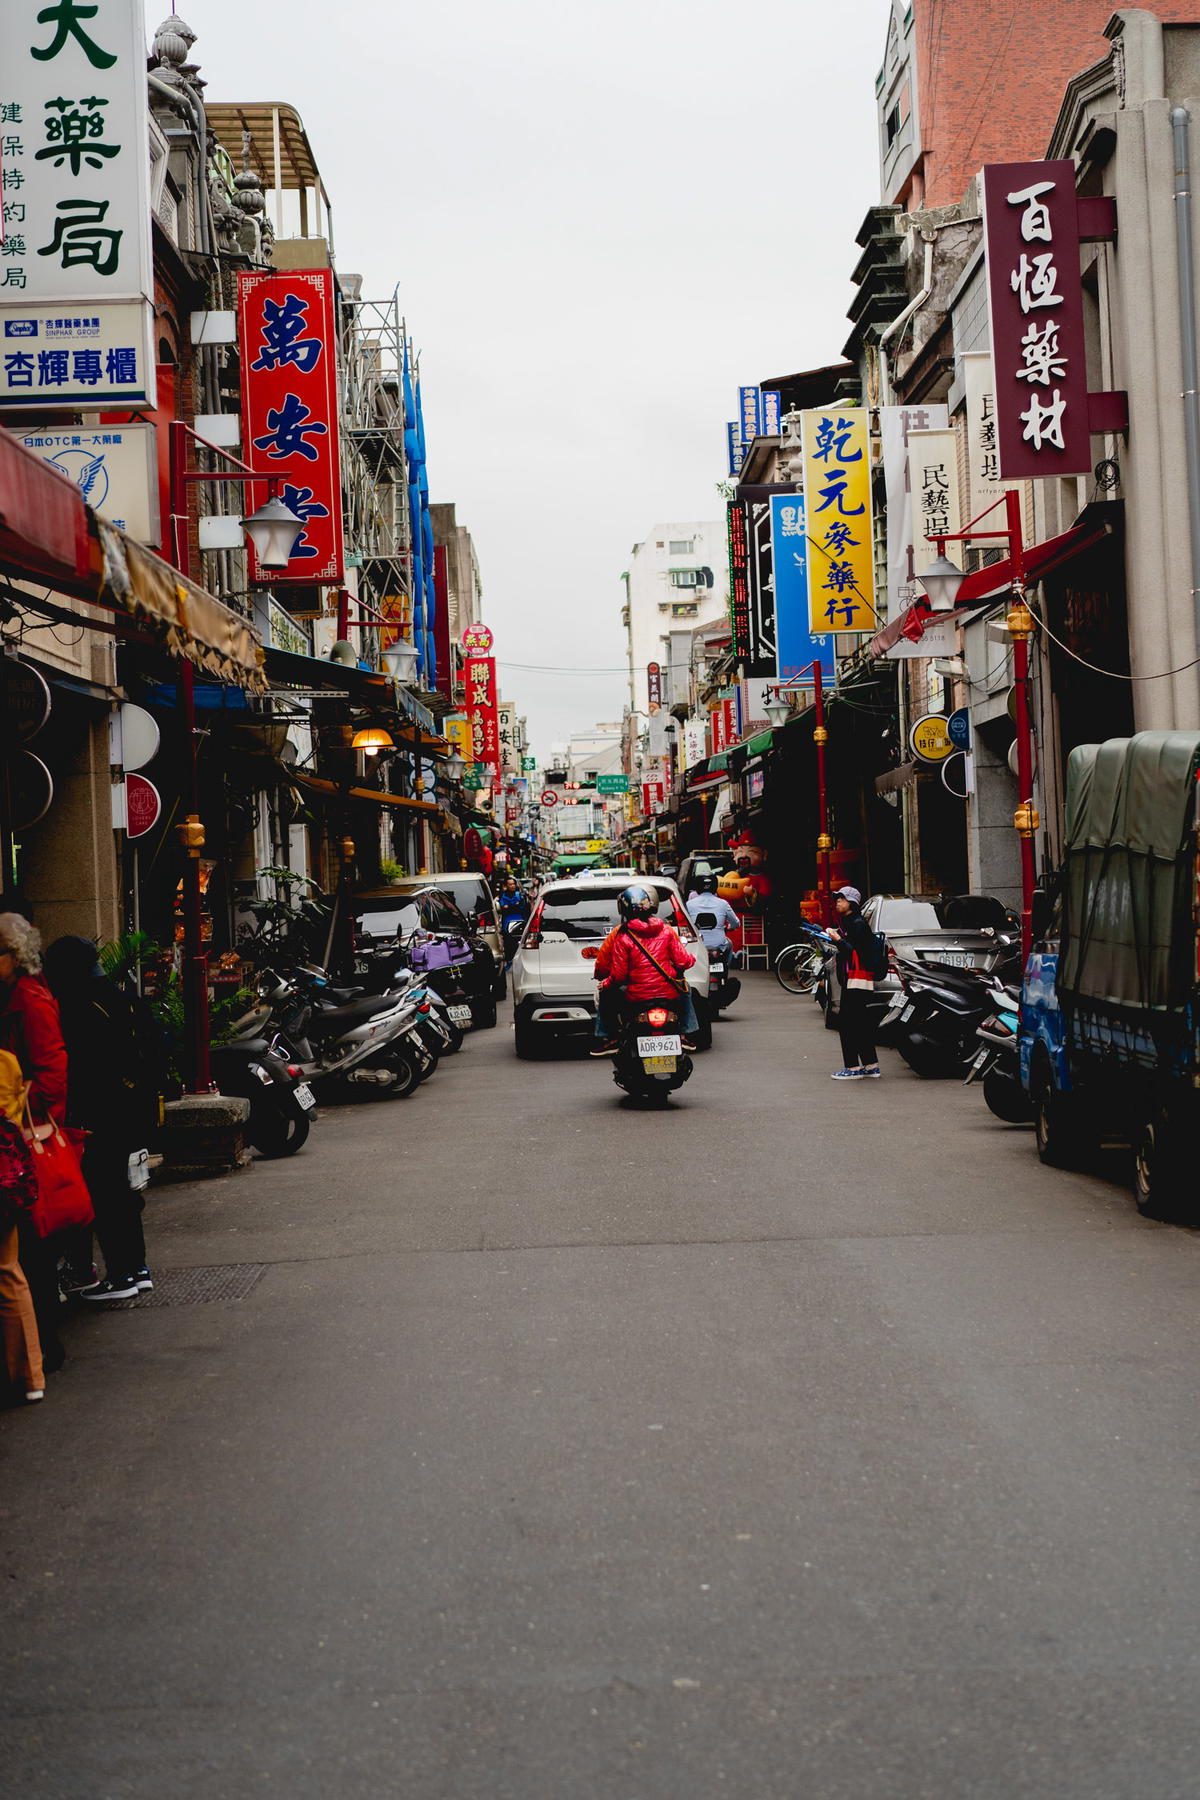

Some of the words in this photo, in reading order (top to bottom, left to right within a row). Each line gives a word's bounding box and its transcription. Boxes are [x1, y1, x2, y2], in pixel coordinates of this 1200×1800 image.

[30, 0, 123, 276] 大藥局
[4, 348, 137, 387] 杏輝專櫃
[812, 417, 865, 626] 乾元參藥行
[498, 709, 512, 767] 百安堂
